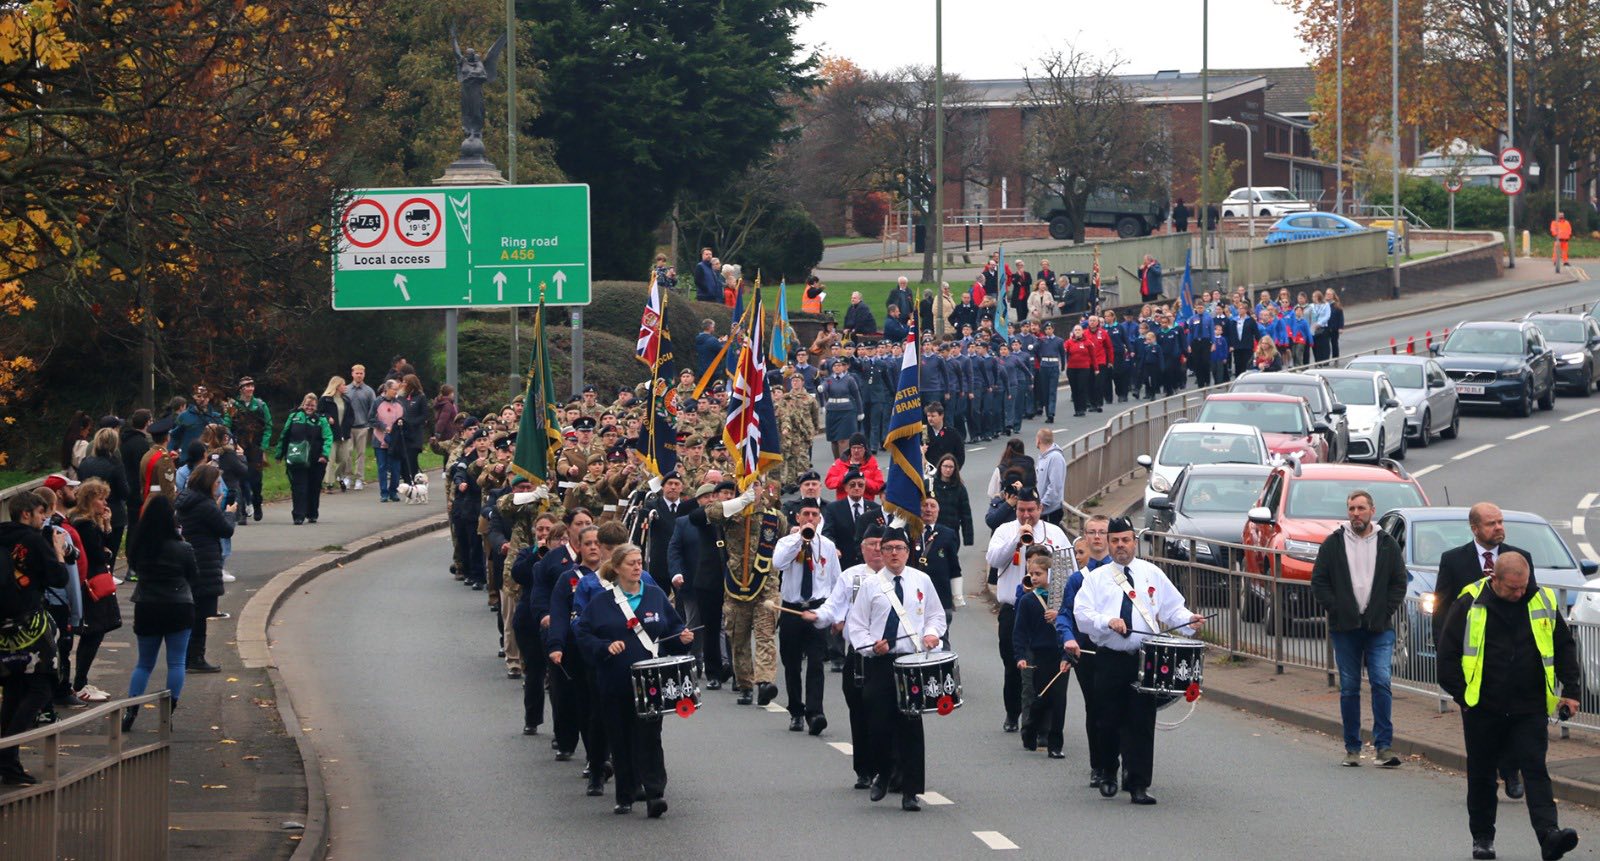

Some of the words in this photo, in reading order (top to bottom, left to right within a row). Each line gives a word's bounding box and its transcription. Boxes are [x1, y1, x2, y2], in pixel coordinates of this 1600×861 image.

[501, 236, 527, 249] Ring
[531, 235, 558, 247] road
[354, 254, 386, 265] Local
[390, 255, 431, 265] access
[500, 249, 535, 260] A456
